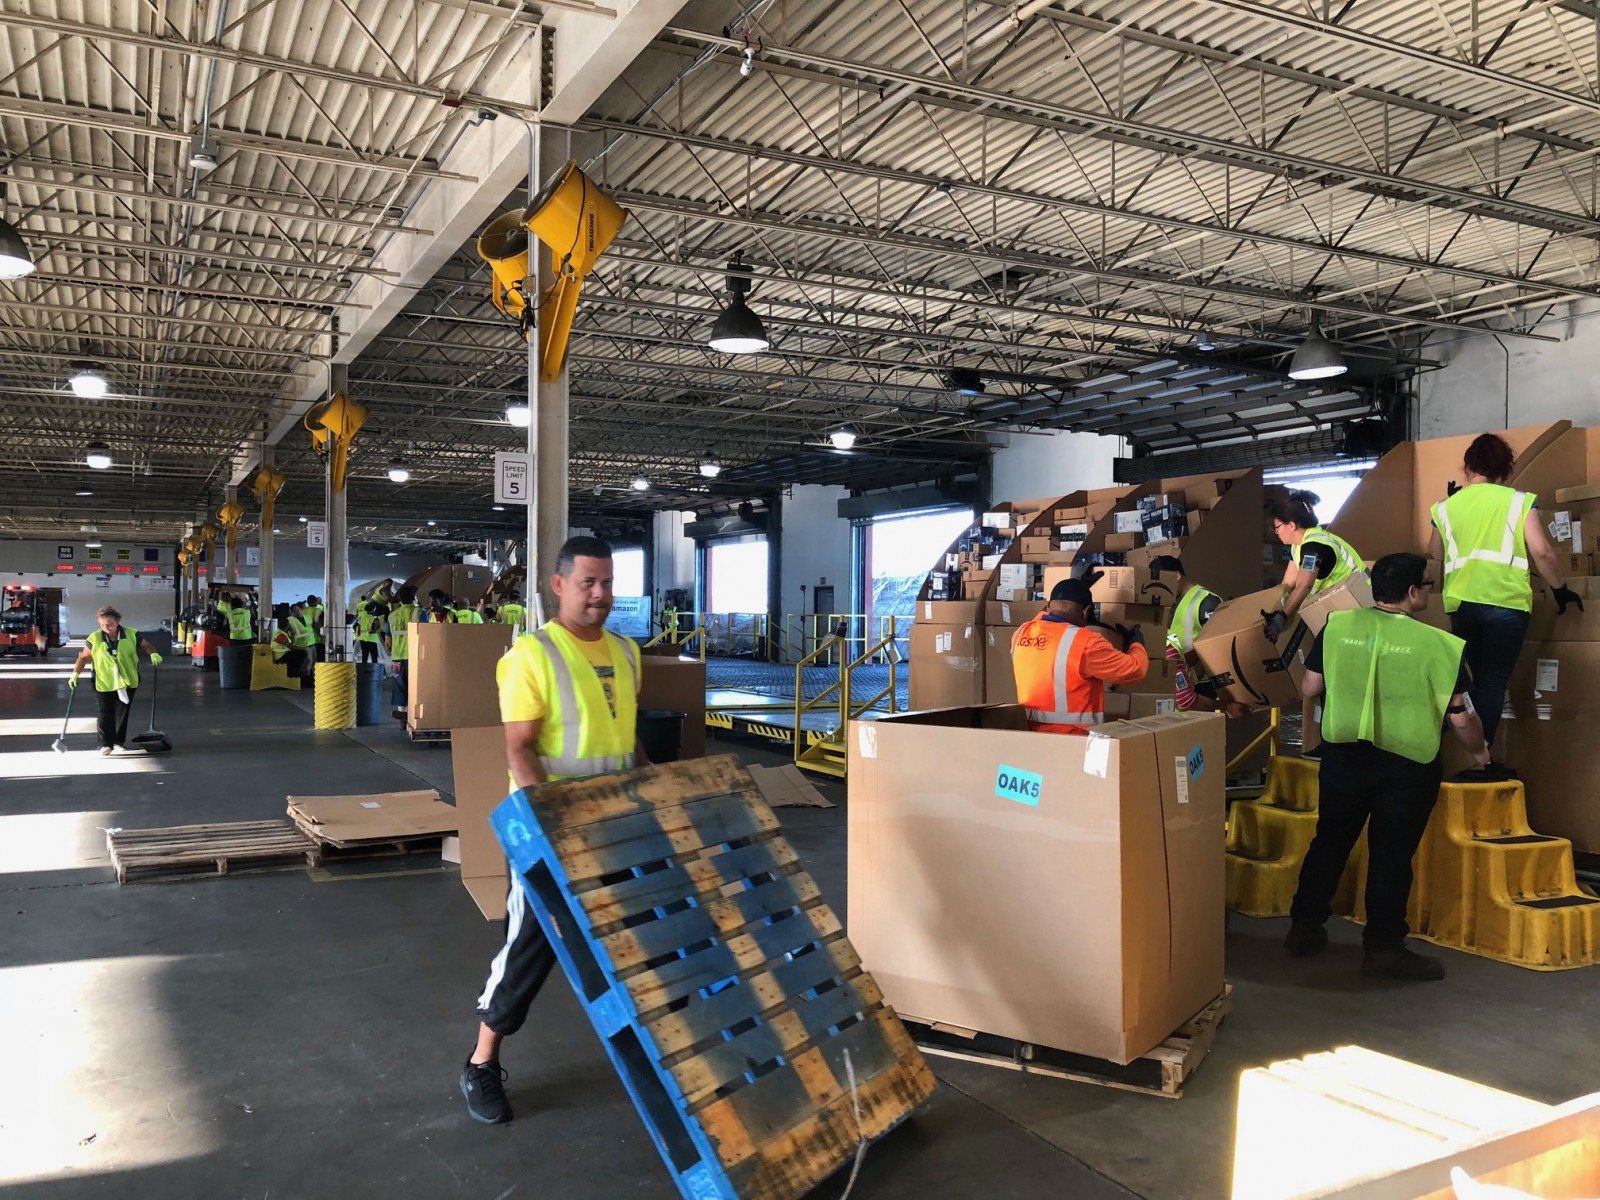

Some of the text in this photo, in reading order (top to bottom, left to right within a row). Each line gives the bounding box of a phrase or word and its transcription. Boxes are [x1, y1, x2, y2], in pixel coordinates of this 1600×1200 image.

[504, 465, 526, 473] SPEED
[510, 482, 520, 494] 5
[1190, 748, 1204, 775] OAK5
[997, 773, 1040, 798] OAK5
